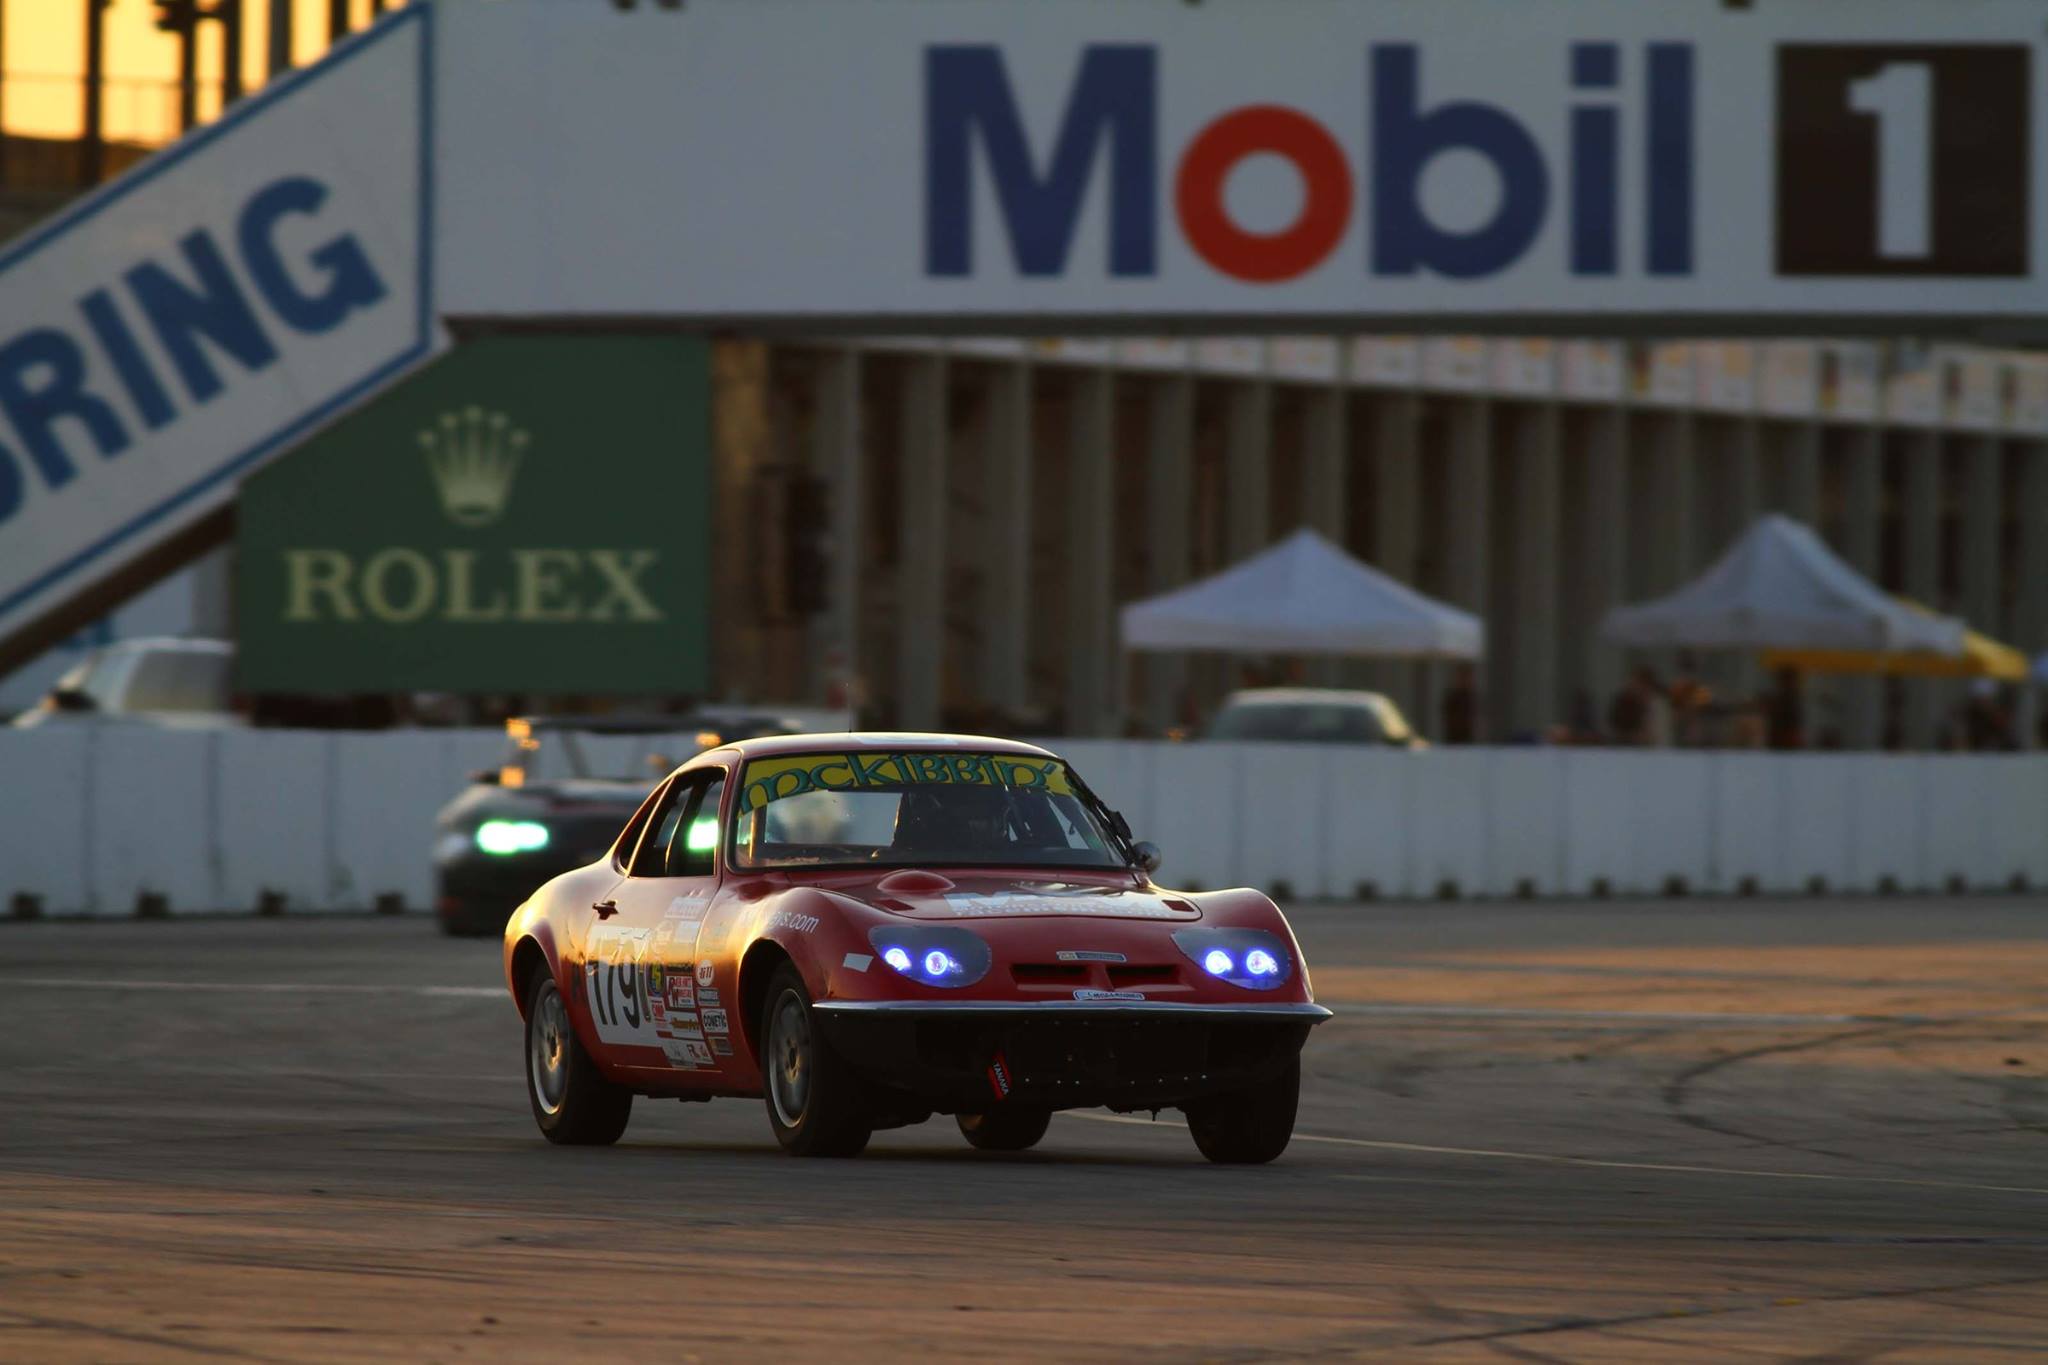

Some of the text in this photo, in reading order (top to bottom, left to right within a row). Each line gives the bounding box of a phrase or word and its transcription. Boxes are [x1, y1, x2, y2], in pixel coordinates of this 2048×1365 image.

[924, 42, 1932, 284] Mobil 1
[0, 176, 388, 525] RING
[283, 548, 663, 622] ROLEX
